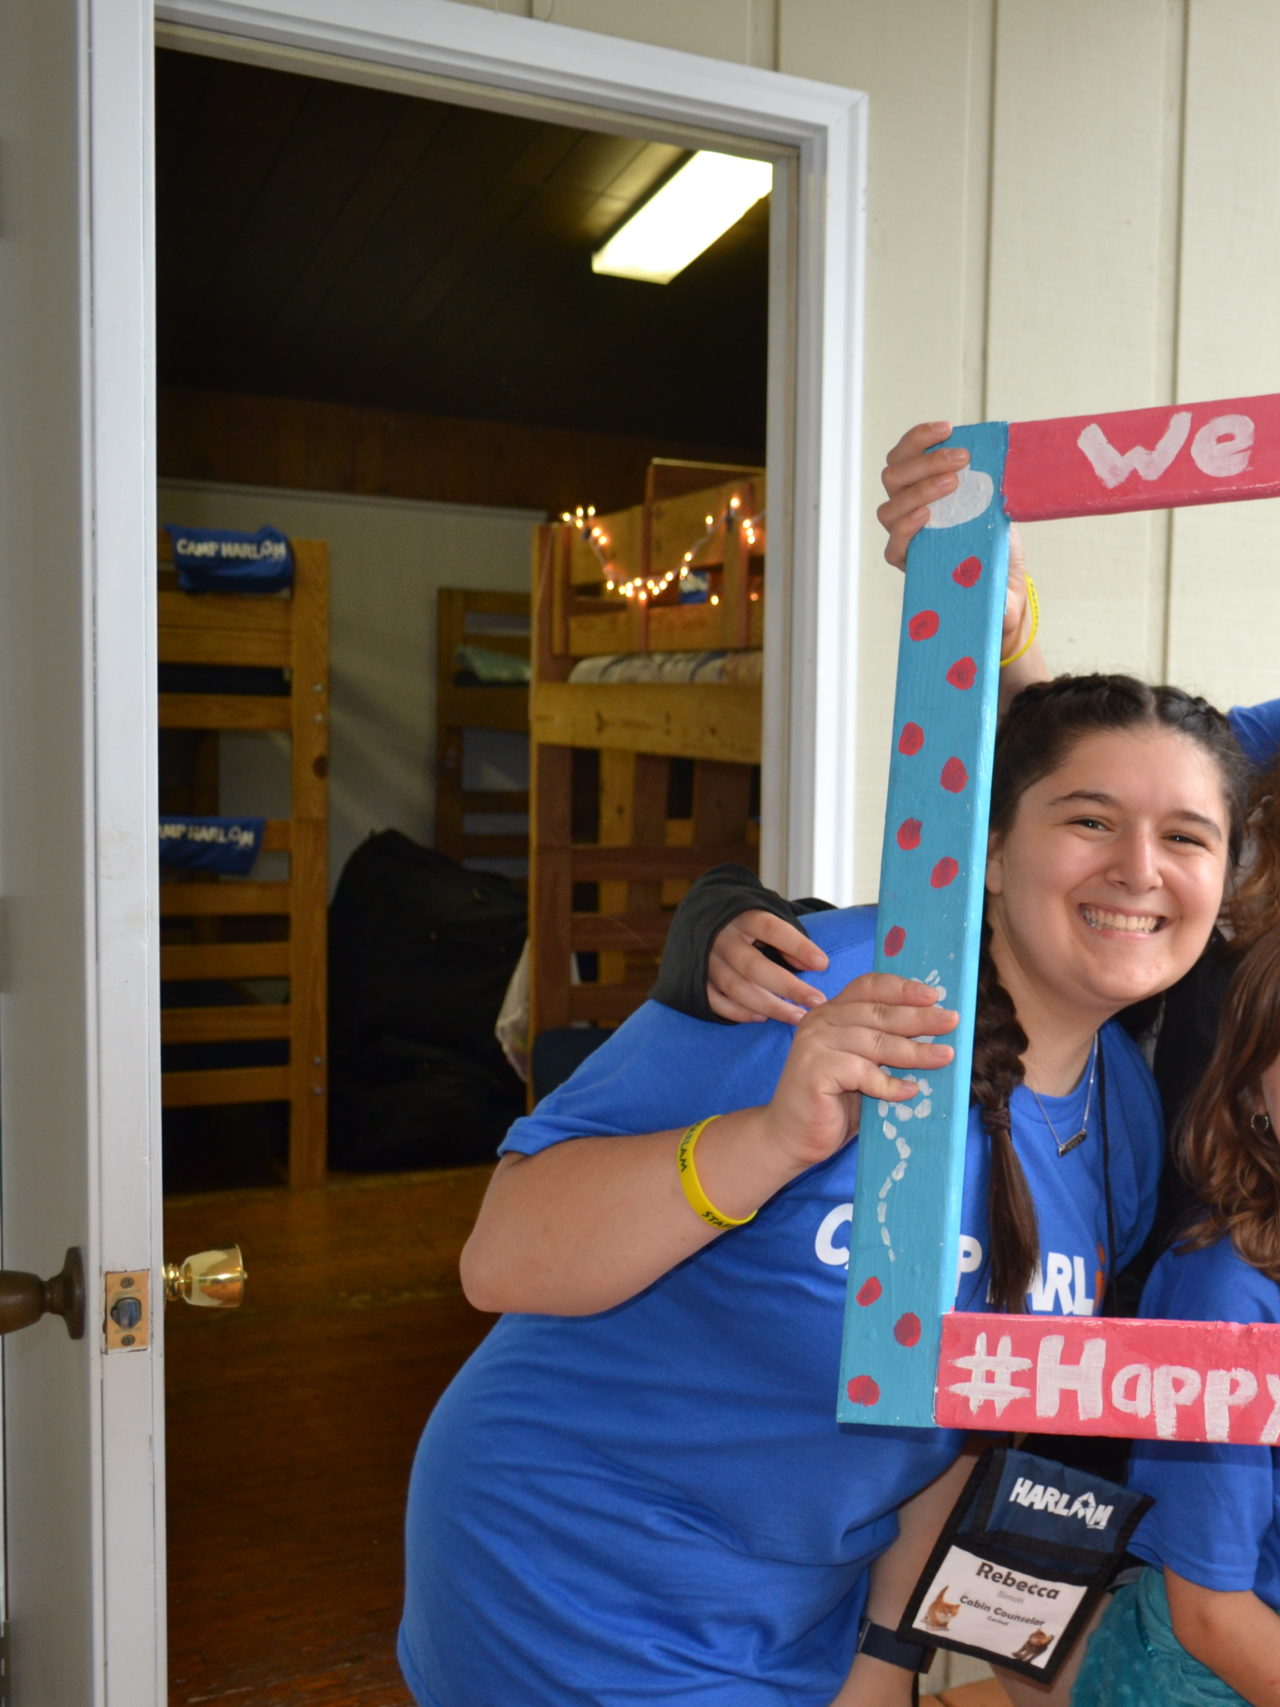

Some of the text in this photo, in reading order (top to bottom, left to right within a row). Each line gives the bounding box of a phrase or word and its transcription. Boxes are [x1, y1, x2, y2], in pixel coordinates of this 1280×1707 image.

[1076, 411, 1256, 490] We
[176, 539, 219, 558] CAMP
[1008, 1477, 1115, 1527] HARLAM
[975, 1561, 1061, 1600] Rebecca
[959, 1595, 992, 1613] Cabin
[993, 1606, 1046, 1627] Counselor
